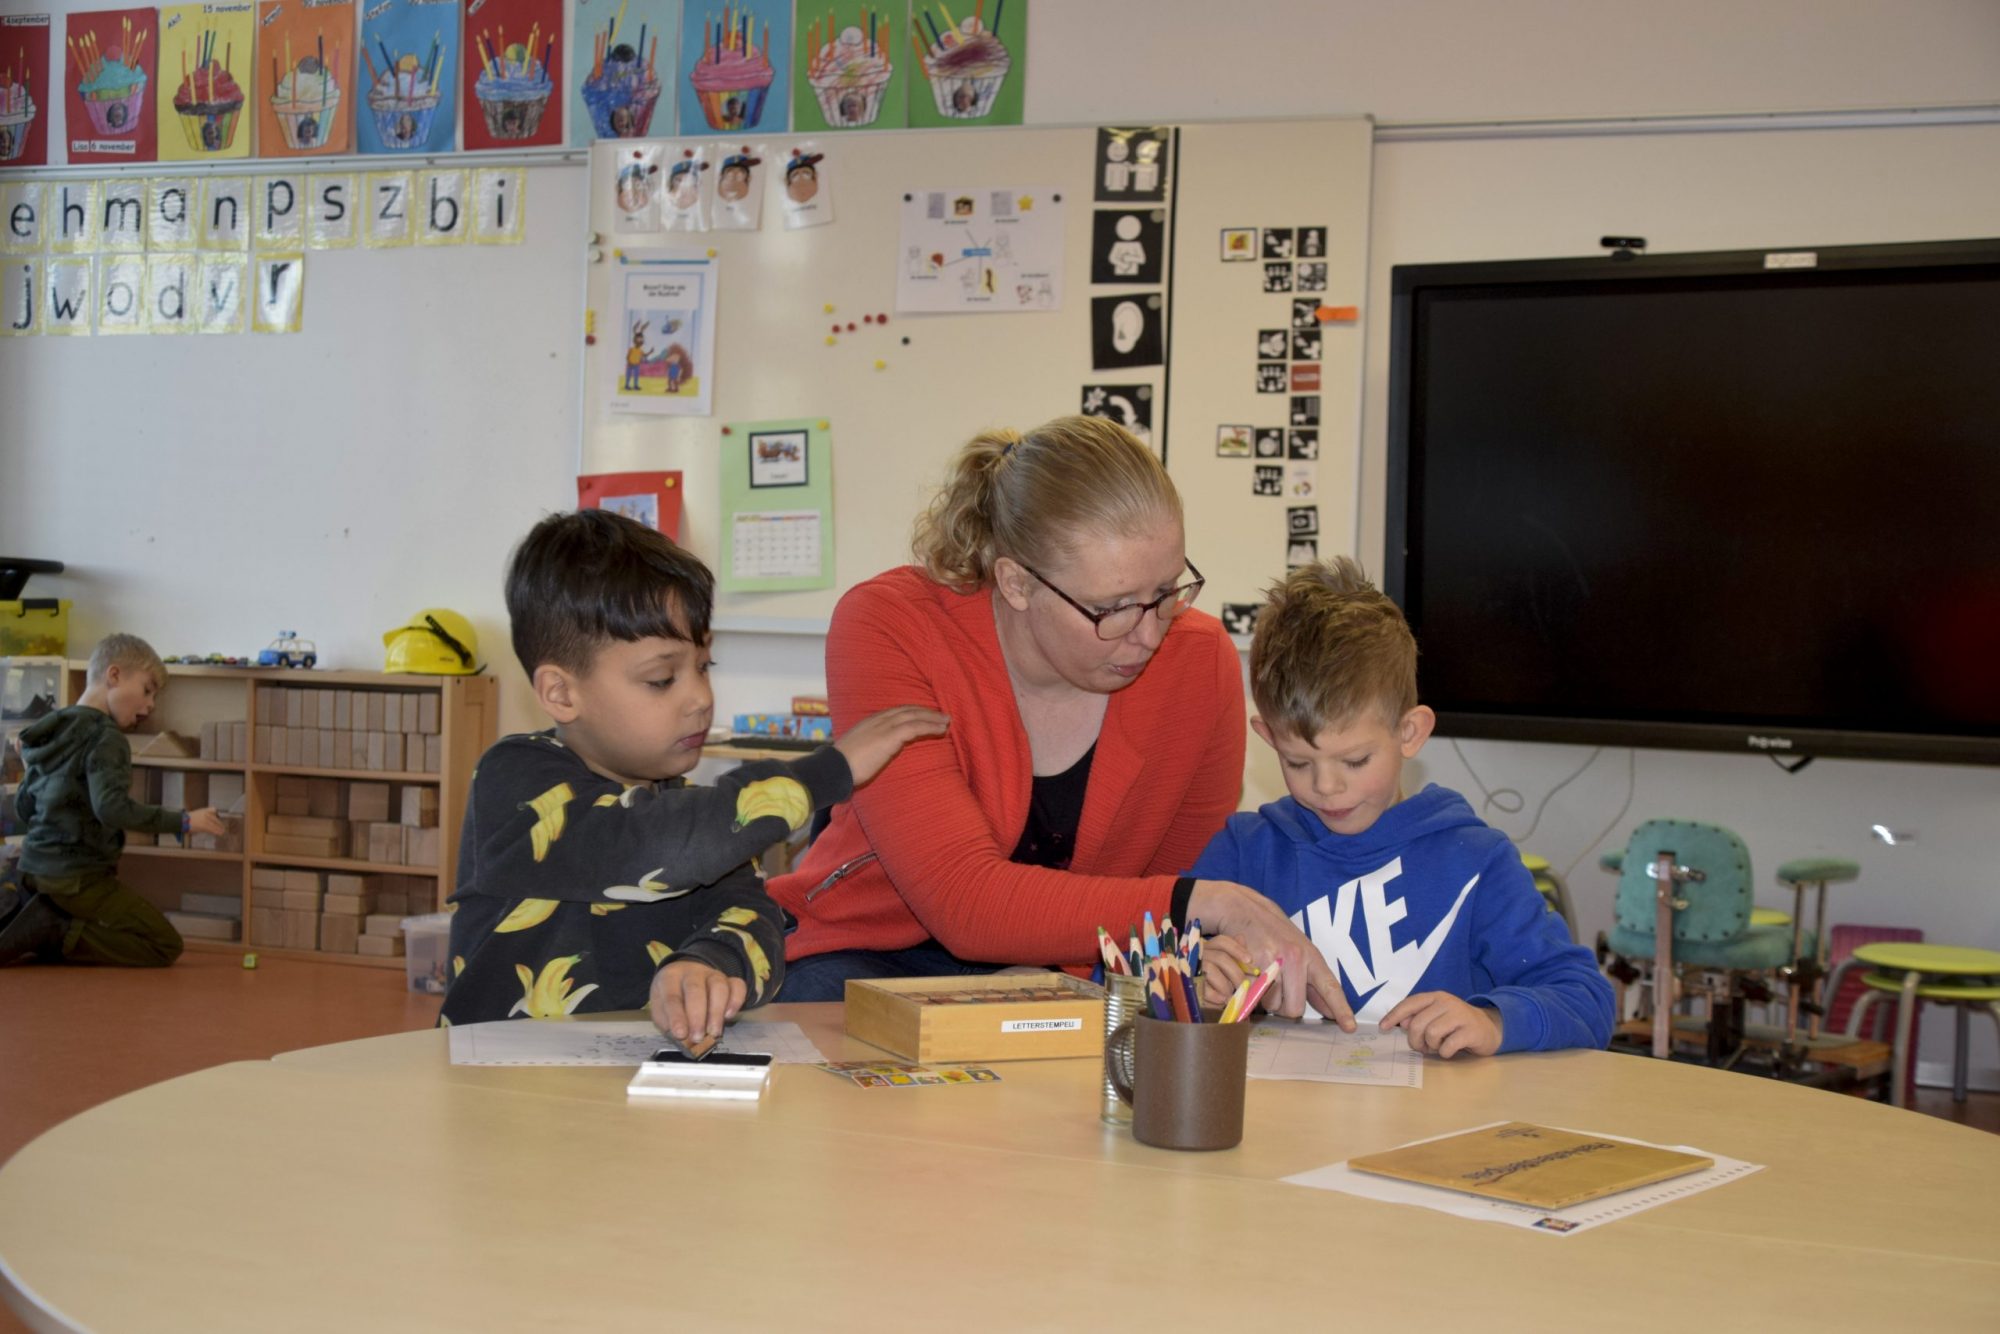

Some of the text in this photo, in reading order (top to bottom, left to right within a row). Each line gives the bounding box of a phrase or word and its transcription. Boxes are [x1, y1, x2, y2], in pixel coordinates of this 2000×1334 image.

[216, 4, 251, 12] november
[99, 143, 134, 152] november
[10, 177, 505, 237] e h m a n p s z b i
[13, 263, 290, 330] j w o d v r
